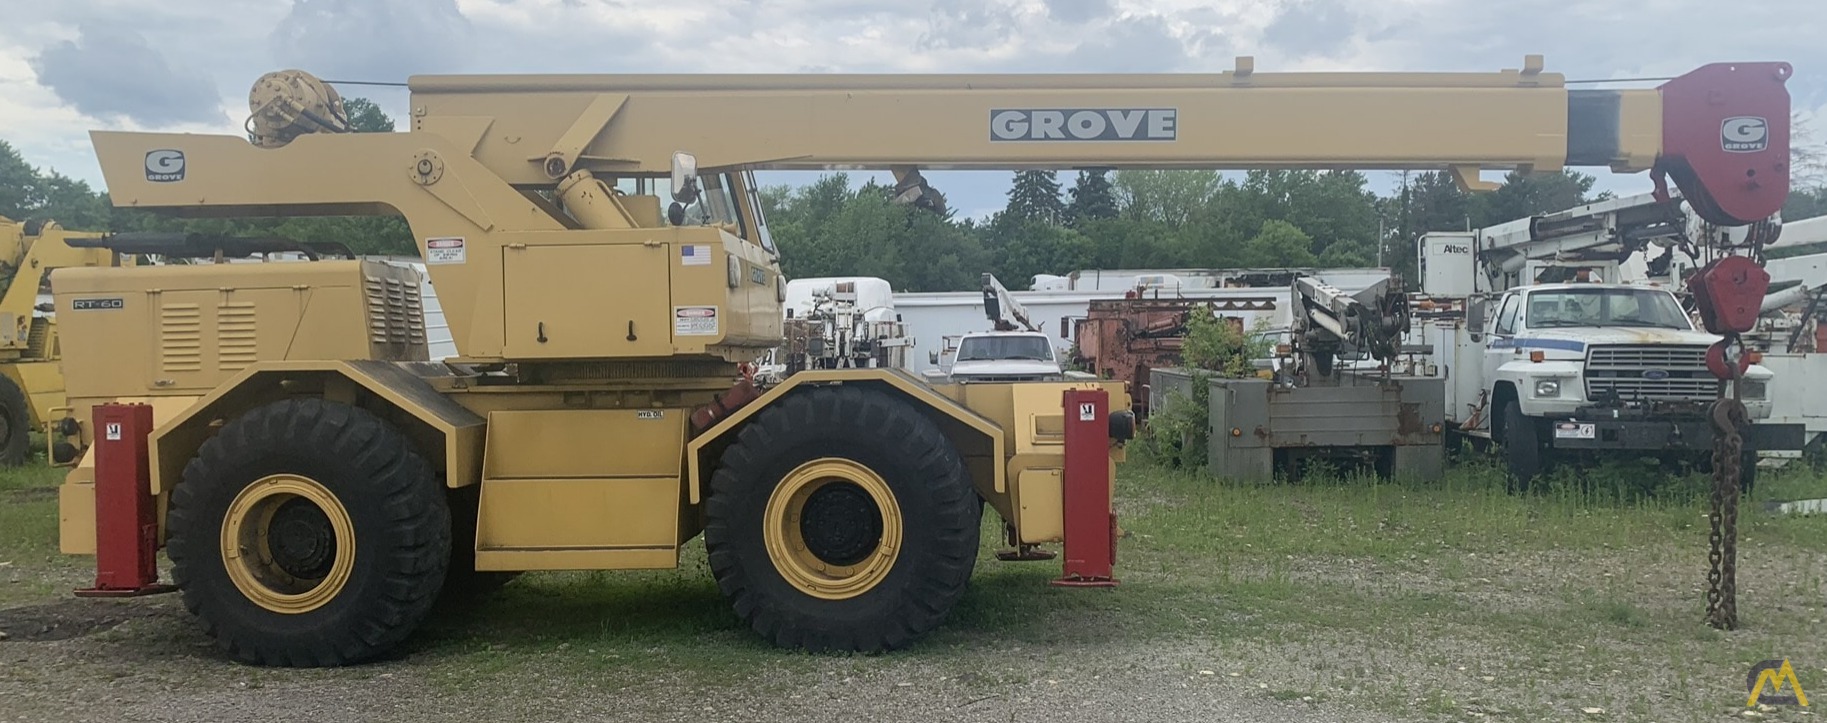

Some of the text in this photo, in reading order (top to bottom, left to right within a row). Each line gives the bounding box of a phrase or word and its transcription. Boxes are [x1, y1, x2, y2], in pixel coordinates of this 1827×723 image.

[991, 110, 1176, 140] GROVE
[1723, 118, 1766, 142] G
[146, 150, 184, 174] G
[1443, 244, 1469, 254] Altec
[74, 300, 122, 309] RT-60
